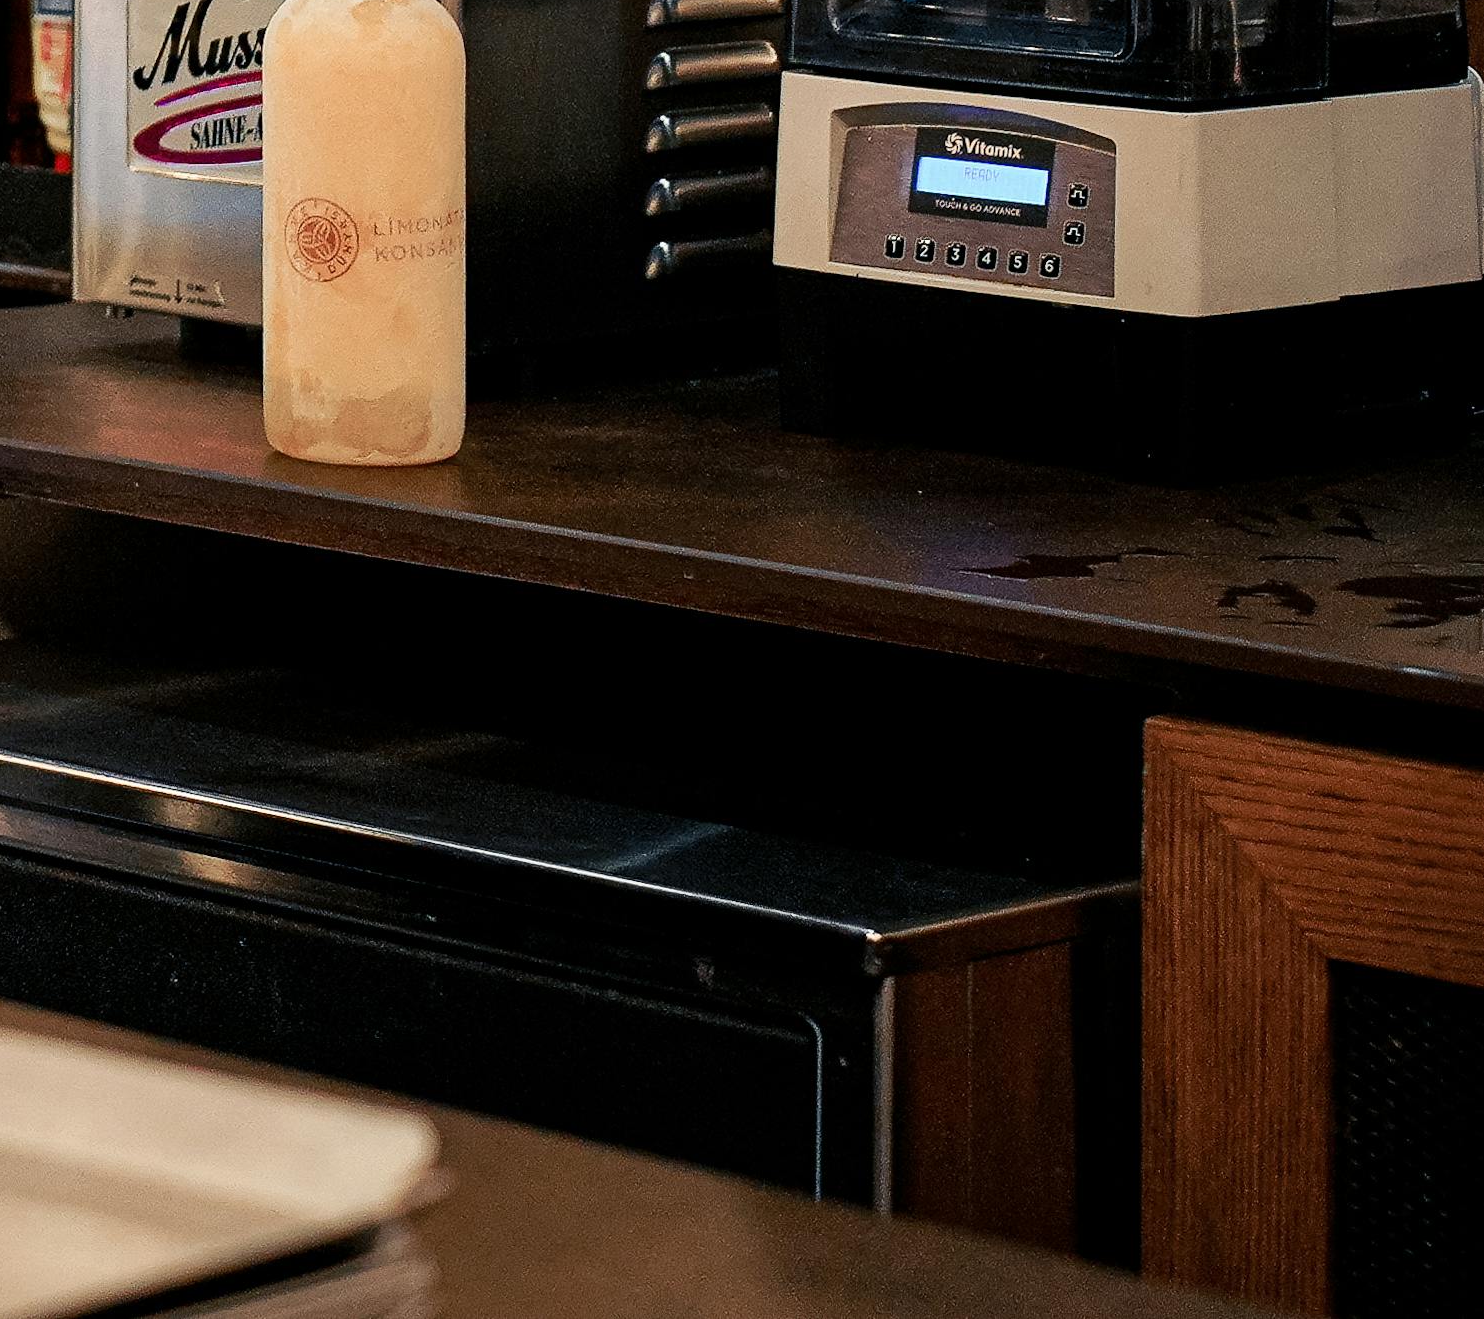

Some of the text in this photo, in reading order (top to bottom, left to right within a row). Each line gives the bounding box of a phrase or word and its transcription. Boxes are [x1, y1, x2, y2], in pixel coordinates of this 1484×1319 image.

[964, 136, 1024, 160] Vitamix
[964, 166, 1000, 182] READY
[935, 199, 961, 211] TOUCH
[983, 205, 1021, 217] ADVANCE
[891, 240, 1054, 273] 1 2 3 4 5 6
